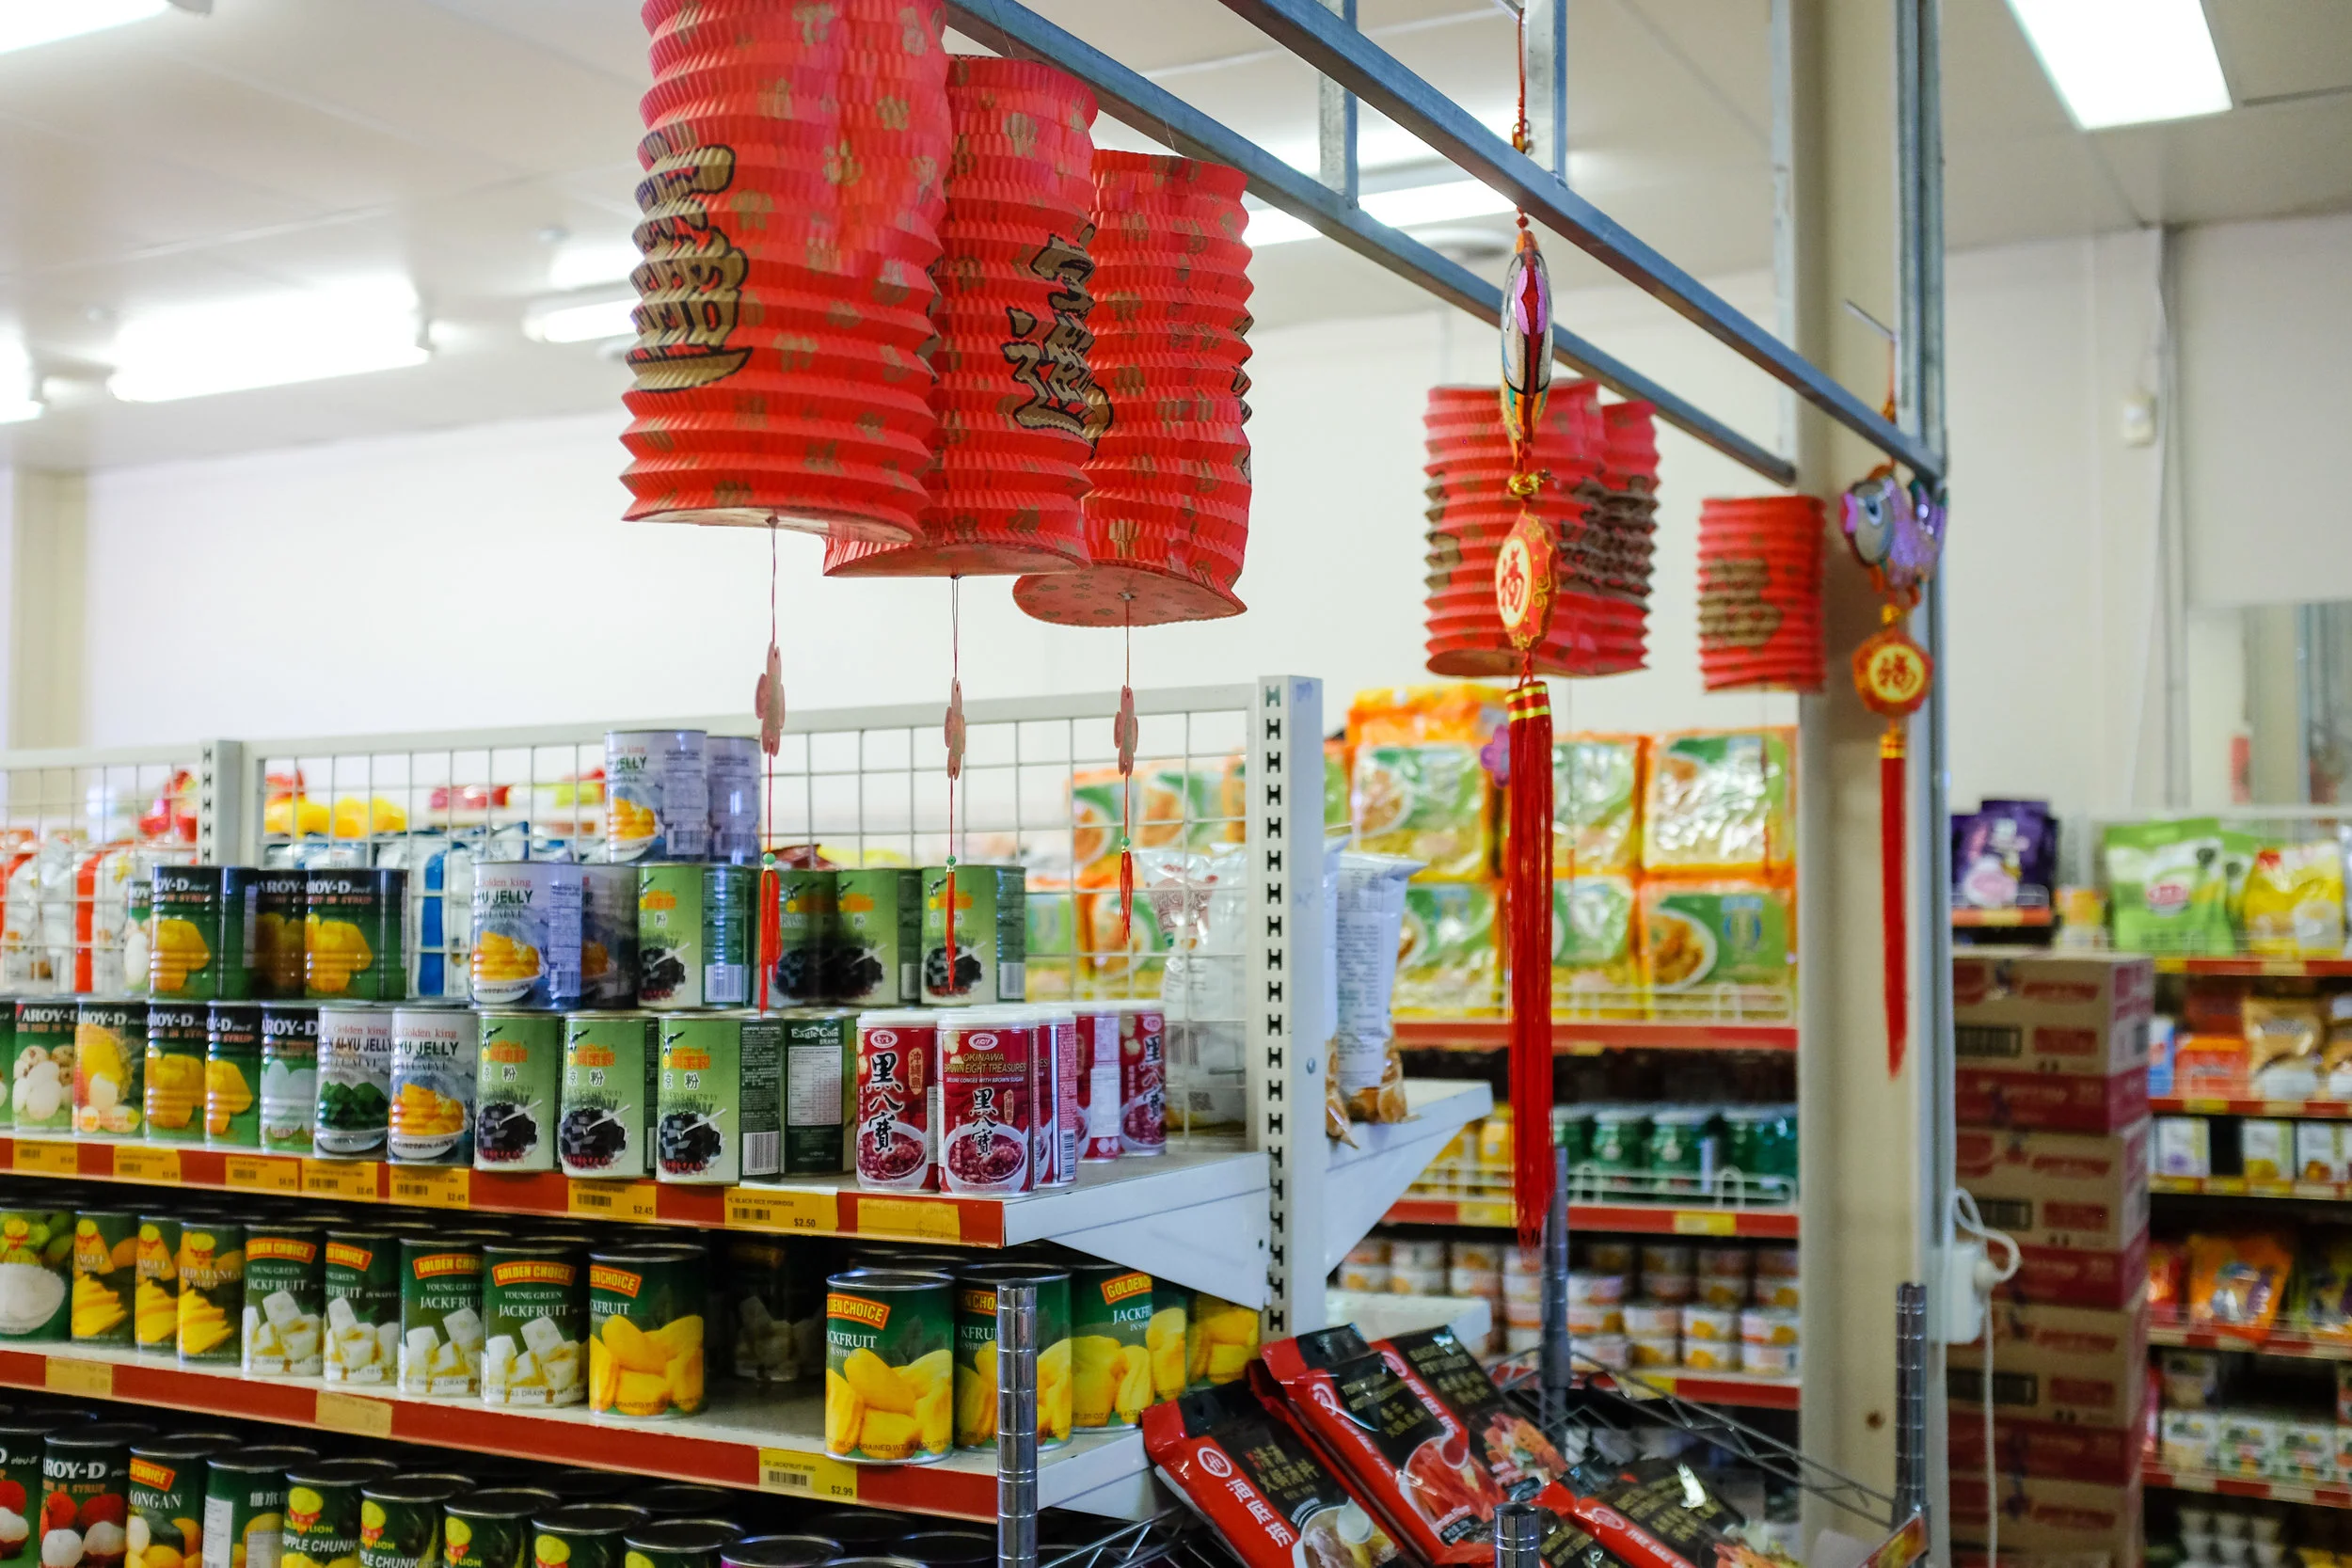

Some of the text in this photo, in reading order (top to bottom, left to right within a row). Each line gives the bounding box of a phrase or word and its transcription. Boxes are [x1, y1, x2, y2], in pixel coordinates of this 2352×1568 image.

[257, 879, 305, 894] AROY-
[492, 890, 533, 904] JELLY
[435, 1028, 457, 1038] king
[416, 1041, 459, 1056] JELLY
[962, 1053, 1005, 1062] OKINAWA
[965, 1063, 987, 1073] EIGHT
[988, 1063, 1026, 1072] TREASURES
[633, 1205, 654, 1215] $2.45
[793, 1217, 816, 1228] $2.50
[418, 1258, 481, 1273] GOLDEN CHOI
[497, 1266, 569, 1280] GOLDEN CHOICE
[426, 1283, 454, 1291] YOUNG
[600, 1273, 636, 1291] CHOICE
[1106, 1276, 1146, 1298] GOLDEN
[420, 1296, 481, 1309] JACKFRUI
[504, 1291, 562, 1300] YOUNG GREEN
[973, 1294, 996, 1310] CHO
[499, 1304, 568, 1318] JACKFRUIT
[843, 1300, 883, 1323] CHOICE
[827, 1329, 878, 1348] ACKFRUIT
[830, 1485, 853, 1497] $2.99
[310, 1525, 333, 1534] LION
[313, 1539, 358, 1553] CHUNK
